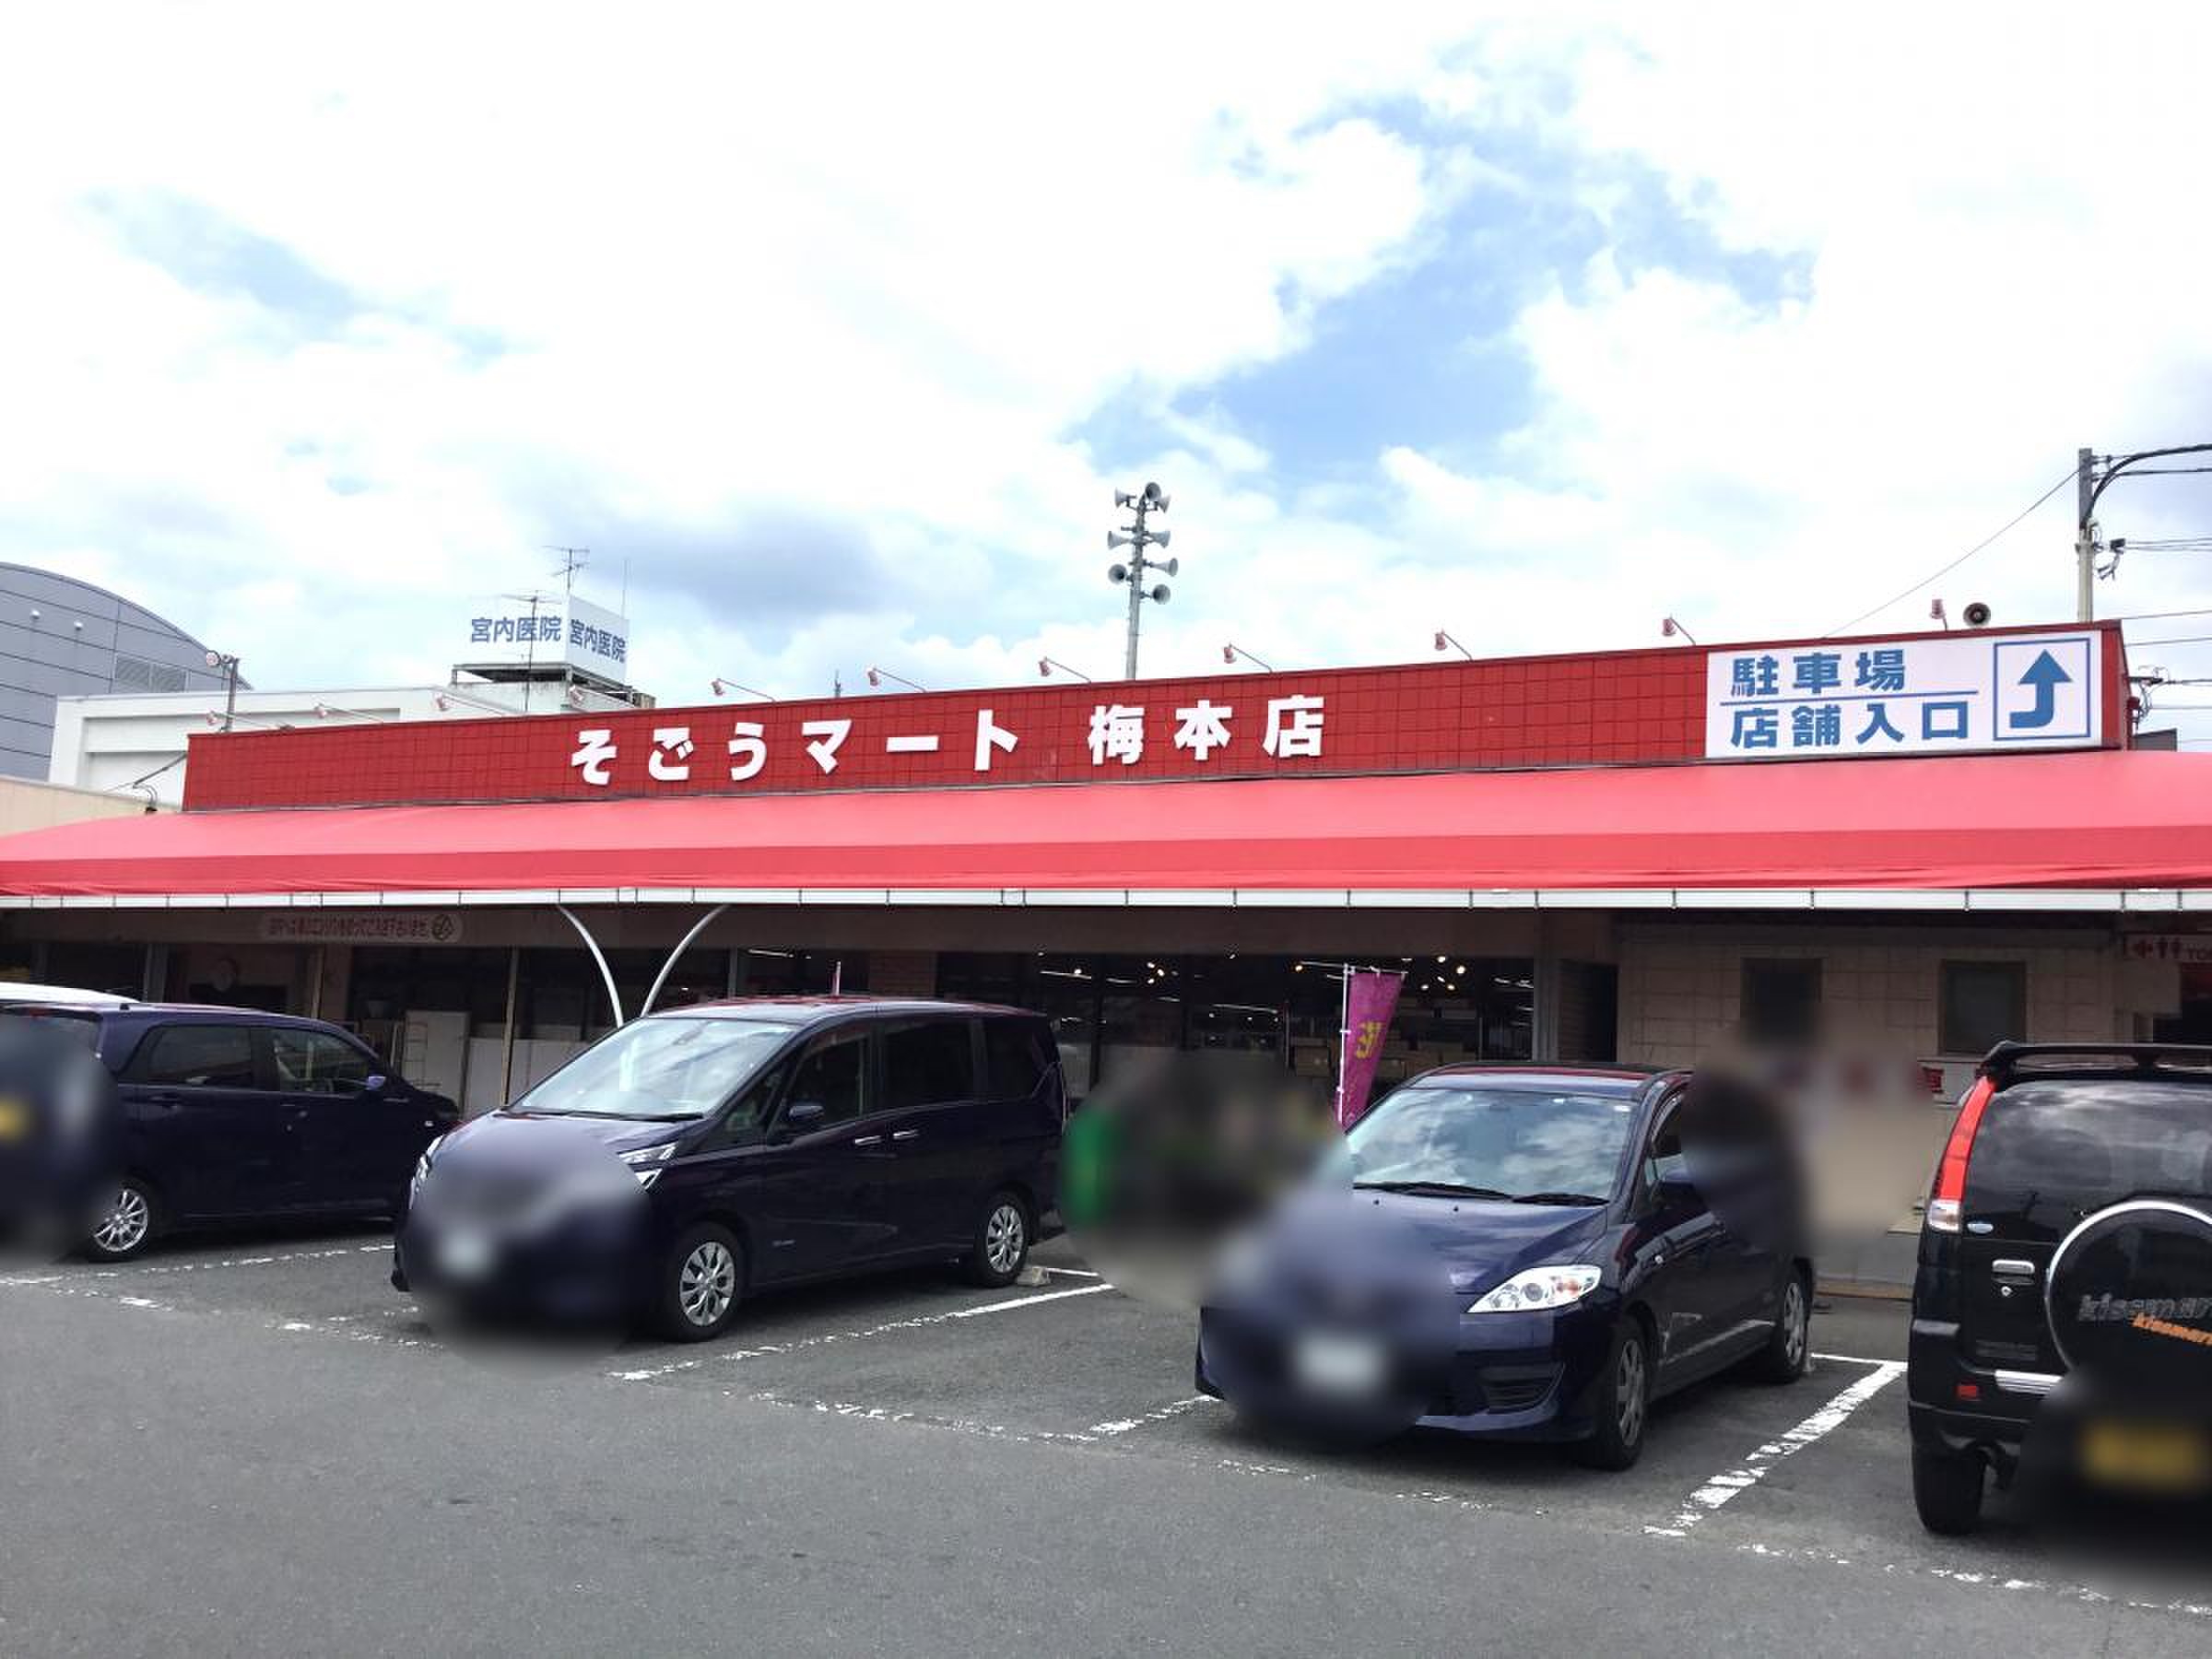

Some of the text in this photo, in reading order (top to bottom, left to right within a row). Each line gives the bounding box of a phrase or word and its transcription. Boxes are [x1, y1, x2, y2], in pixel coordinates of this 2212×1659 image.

[471, 616, 561, 643] 宮内医院
[570, 618, 626, 663] 宮内医院
[1731, 649, 1905, 698] 駐車場
[571, 694, 1326, 785] そごうマート 梅本店
[1731, 700, 1970, 749] 店舗入口
